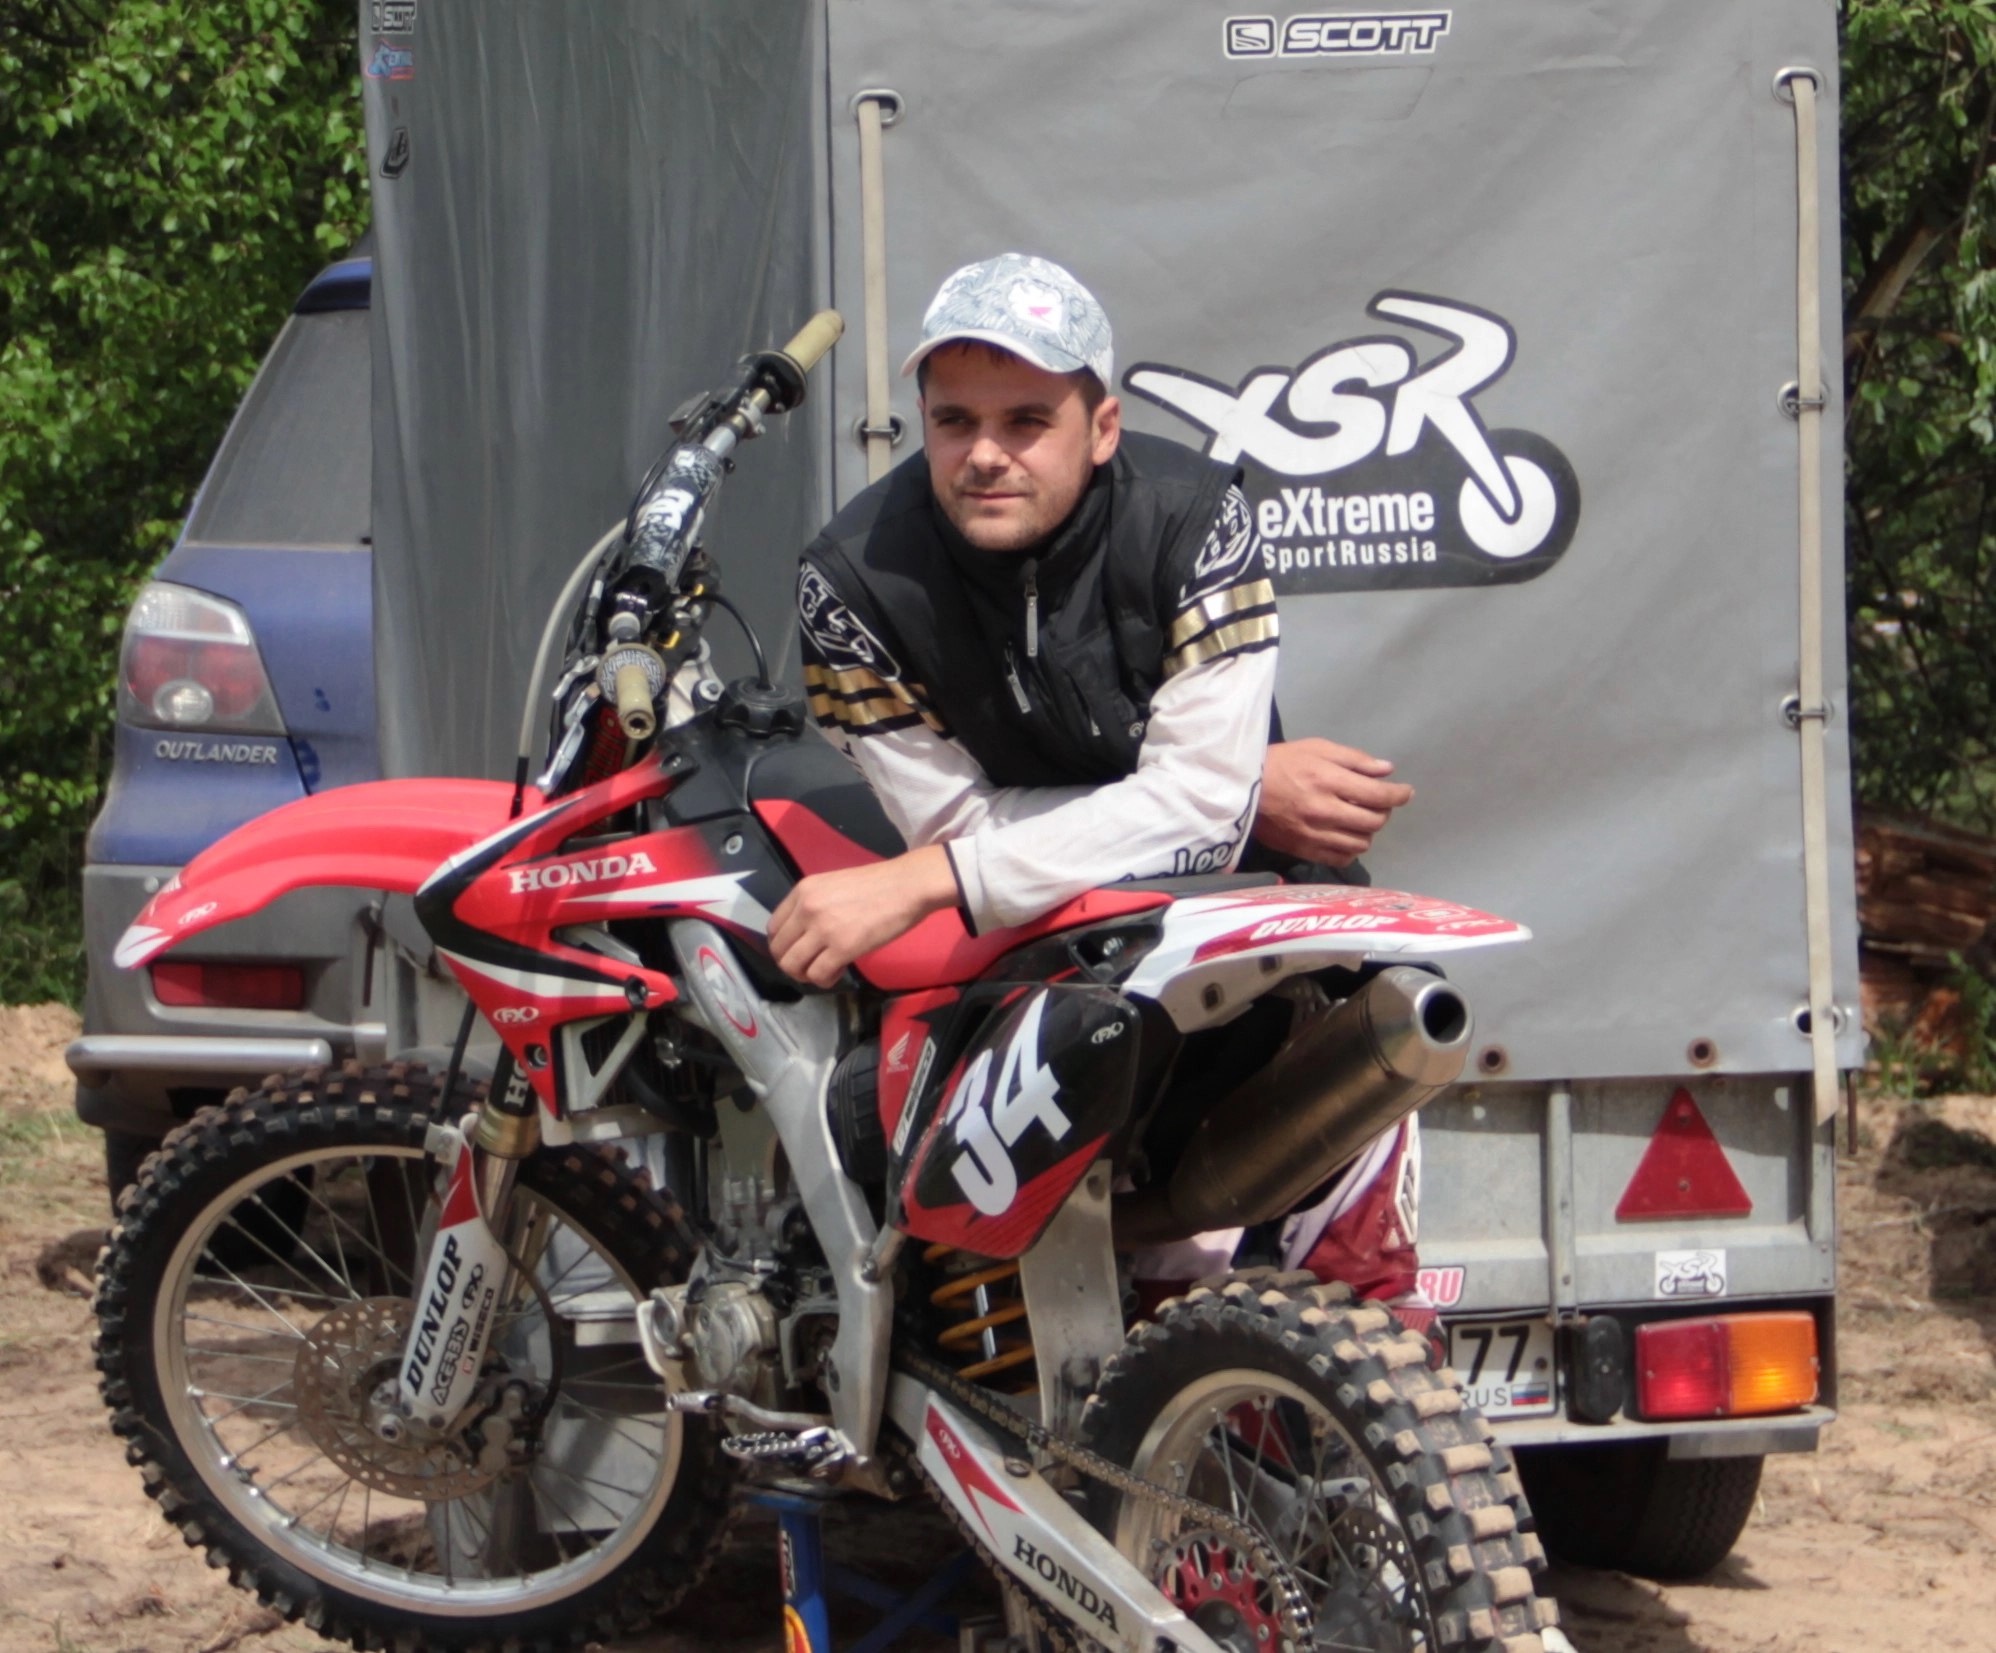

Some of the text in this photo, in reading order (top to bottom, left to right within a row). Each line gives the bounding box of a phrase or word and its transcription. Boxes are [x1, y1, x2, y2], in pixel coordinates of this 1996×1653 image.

[1284, 17, 1444, 51] SCOTT
[1130, 297, 1517, 517] XSR
[1257, 487, 1435, 539] eXtreme
[1261, 536, 1437, 575] SportRussia
[155, 739, 277, 764] OUTLANDER
[508, 851, 658, 894] HONDA
[1249, 913, 1401, 941] DUNLOP
[950, 988, 1073, 1217] 34
[406, 1233, 463, 1397] DUNLOP
[1460, 1325, 1530, 1386] 77
[1013, 1534, 1120, 1635] HONDA
